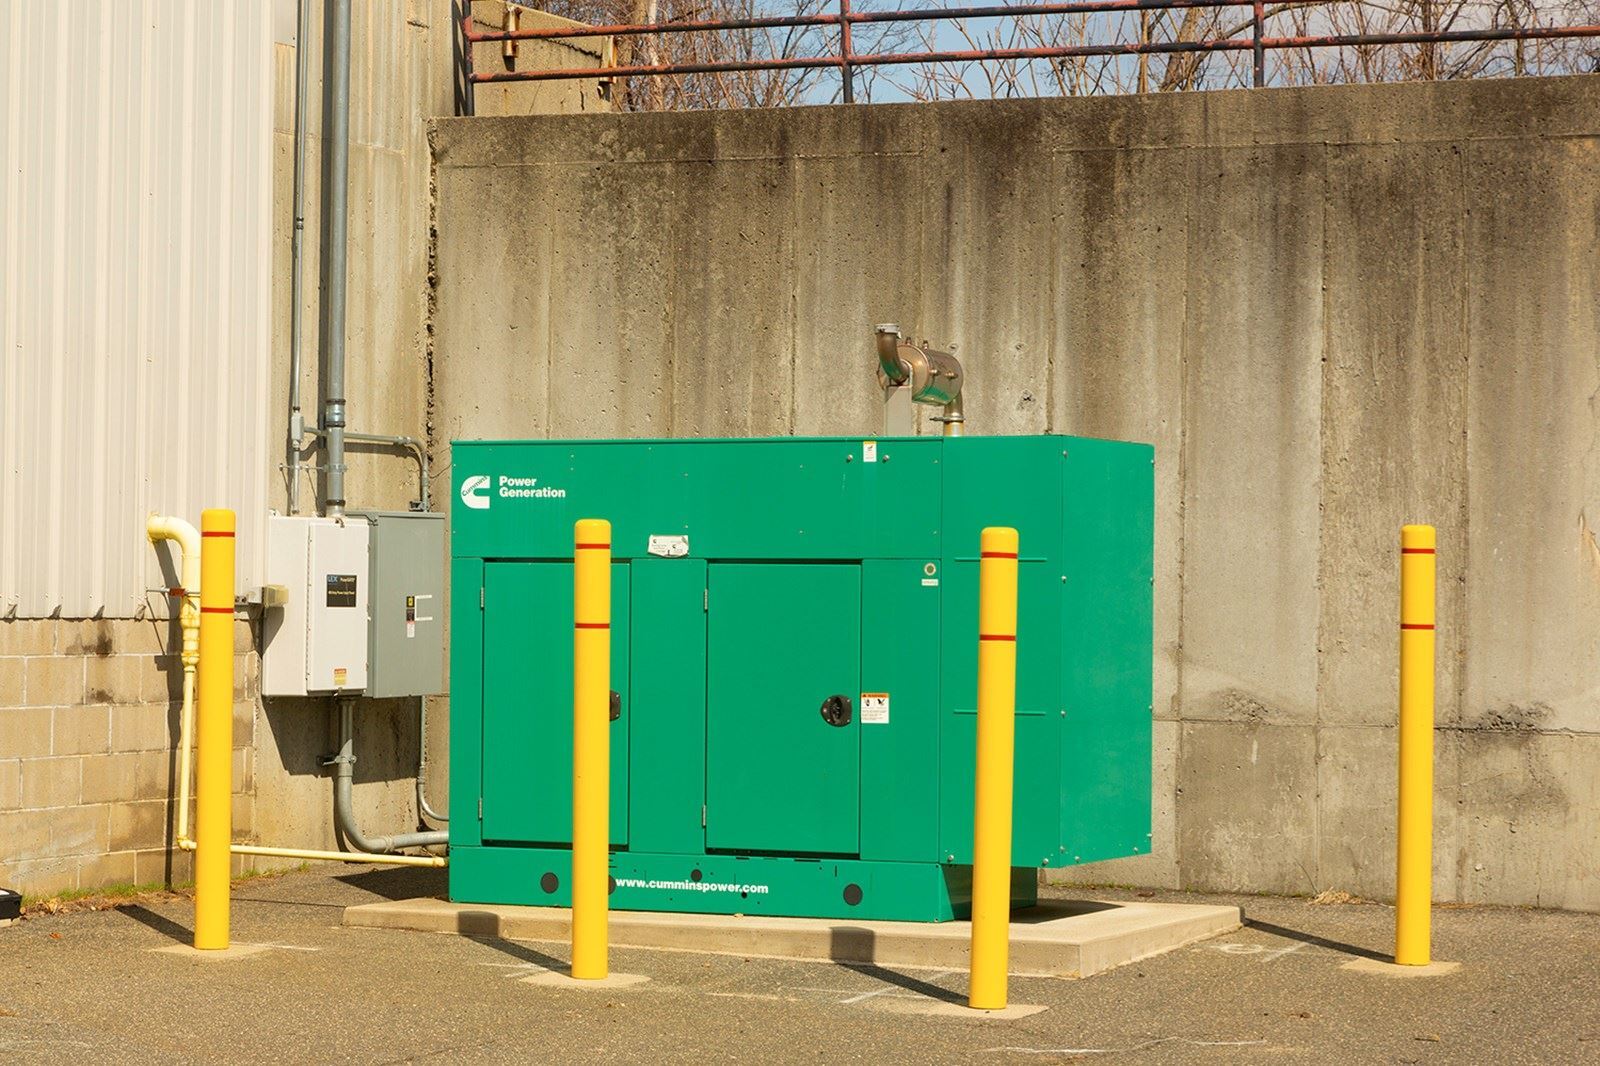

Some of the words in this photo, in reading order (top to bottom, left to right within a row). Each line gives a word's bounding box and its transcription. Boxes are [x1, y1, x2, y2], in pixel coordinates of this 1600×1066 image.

[500, 476, 536, 486] Power
[499, 487, 565, 497] Generation
[615, 879, 768, 893] www.cumminspower.com
